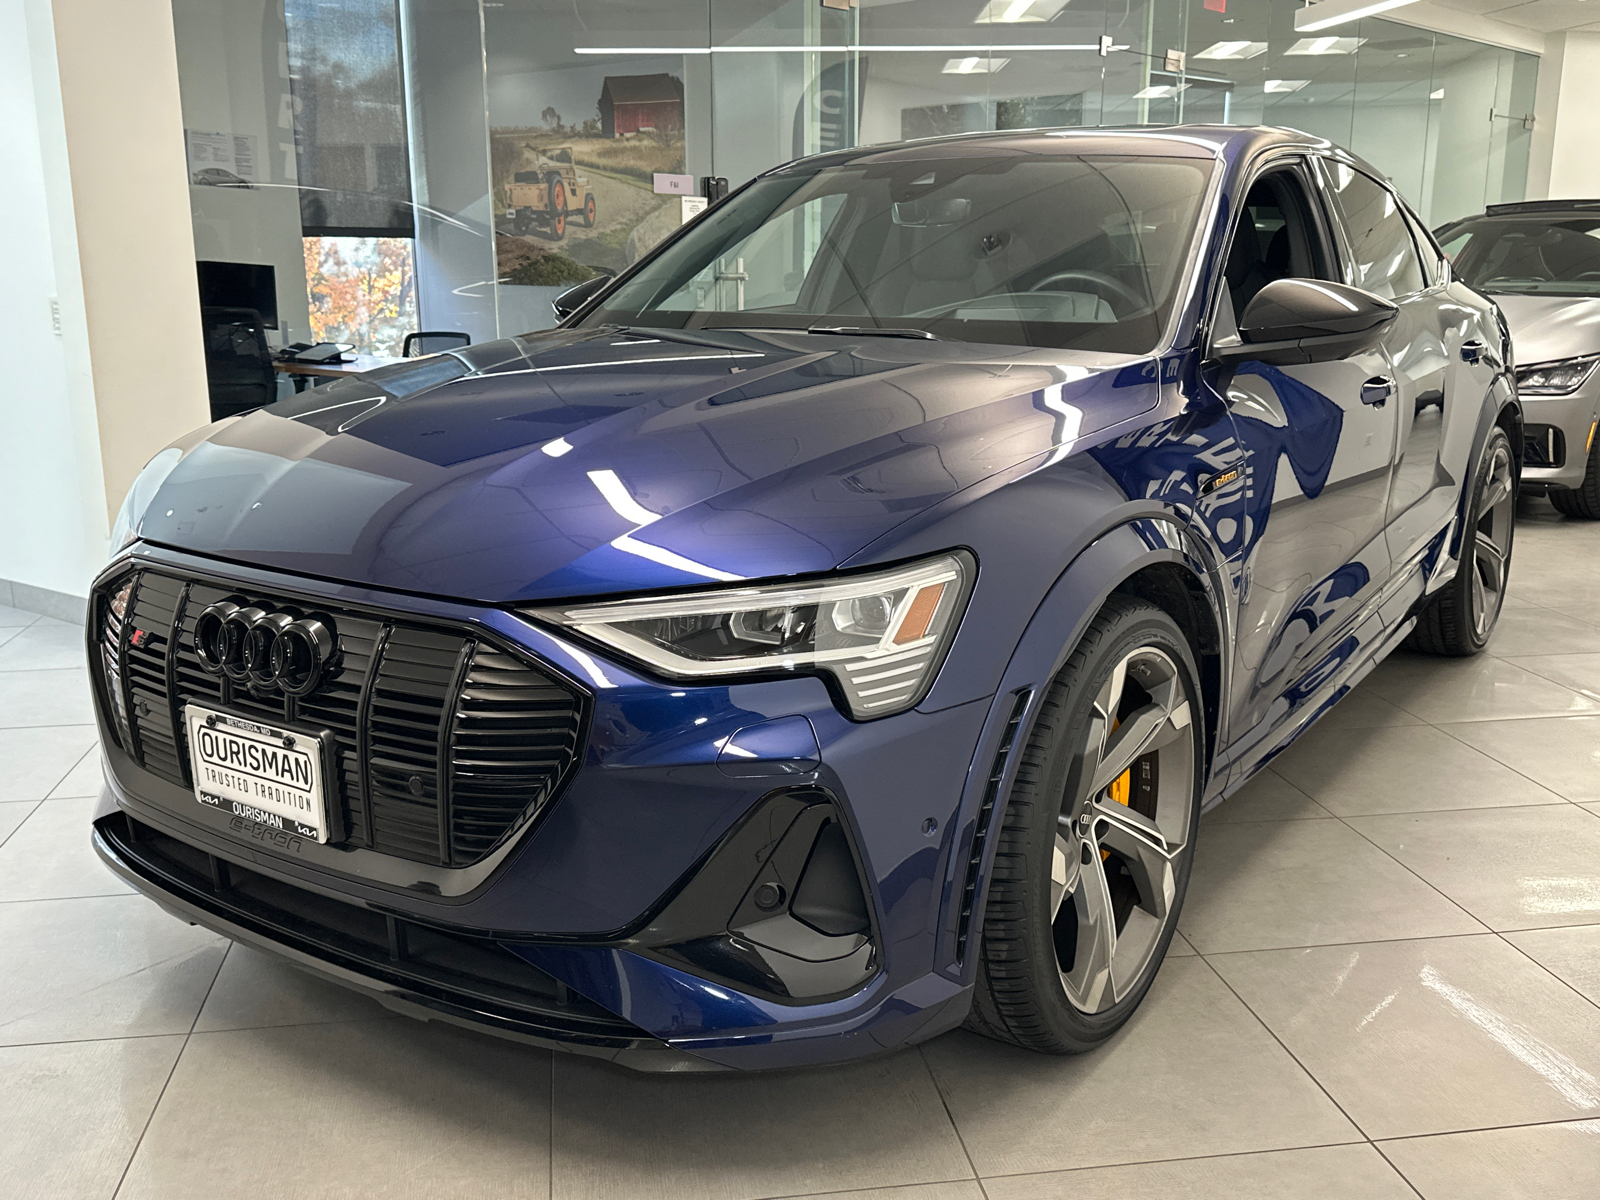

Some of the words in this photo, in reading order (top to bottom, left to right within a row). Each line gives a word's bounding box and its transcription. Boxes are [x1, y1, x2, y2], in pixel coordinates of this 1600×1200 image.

[260, 727, 271, 736] MD
[201, 732, 309, 786] OURISMAN
[205, 767, 249, 793] TRUSTED
[254, 782, 312, 813] TRADITION
[232, 801, 283, 829] OURISMAN
[229, 816, 303, 853] e-tron
